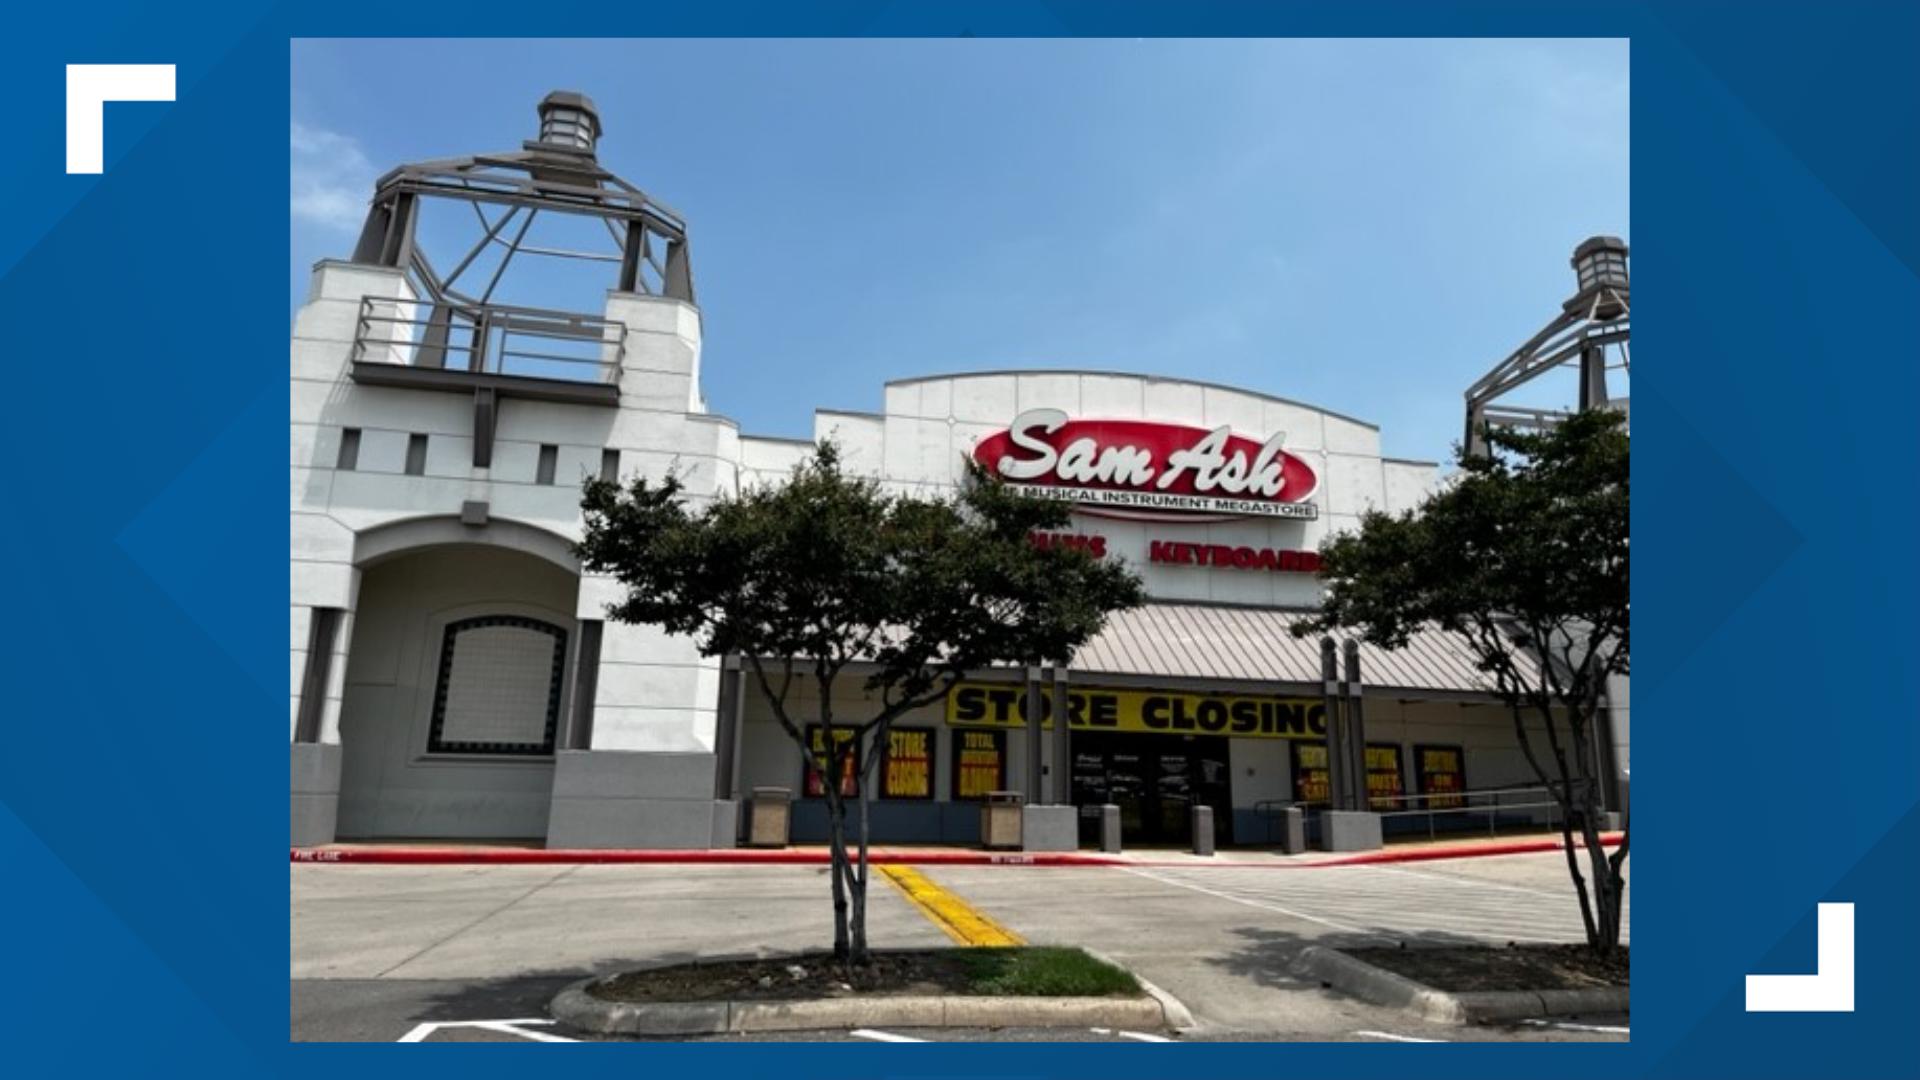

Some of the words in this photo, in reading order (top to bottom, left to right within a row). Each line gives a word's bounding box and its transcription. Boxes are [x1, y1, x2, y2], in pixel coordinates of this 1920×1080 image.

[998, 408, 1155, 485] Sam
[1157, 425, 1287, 498] Ash
[1024, 486, 1099, 501] MUSICAL
[1103, 491, 1209, 509] INSTRUMENT
[1215, 498, 1313, 517] MEGASTORE
[1150, 540, 1328, 572] KEYBOARD
[956, 688, 1118, 726] STORE
[889, 731, 928, 759] STORE
